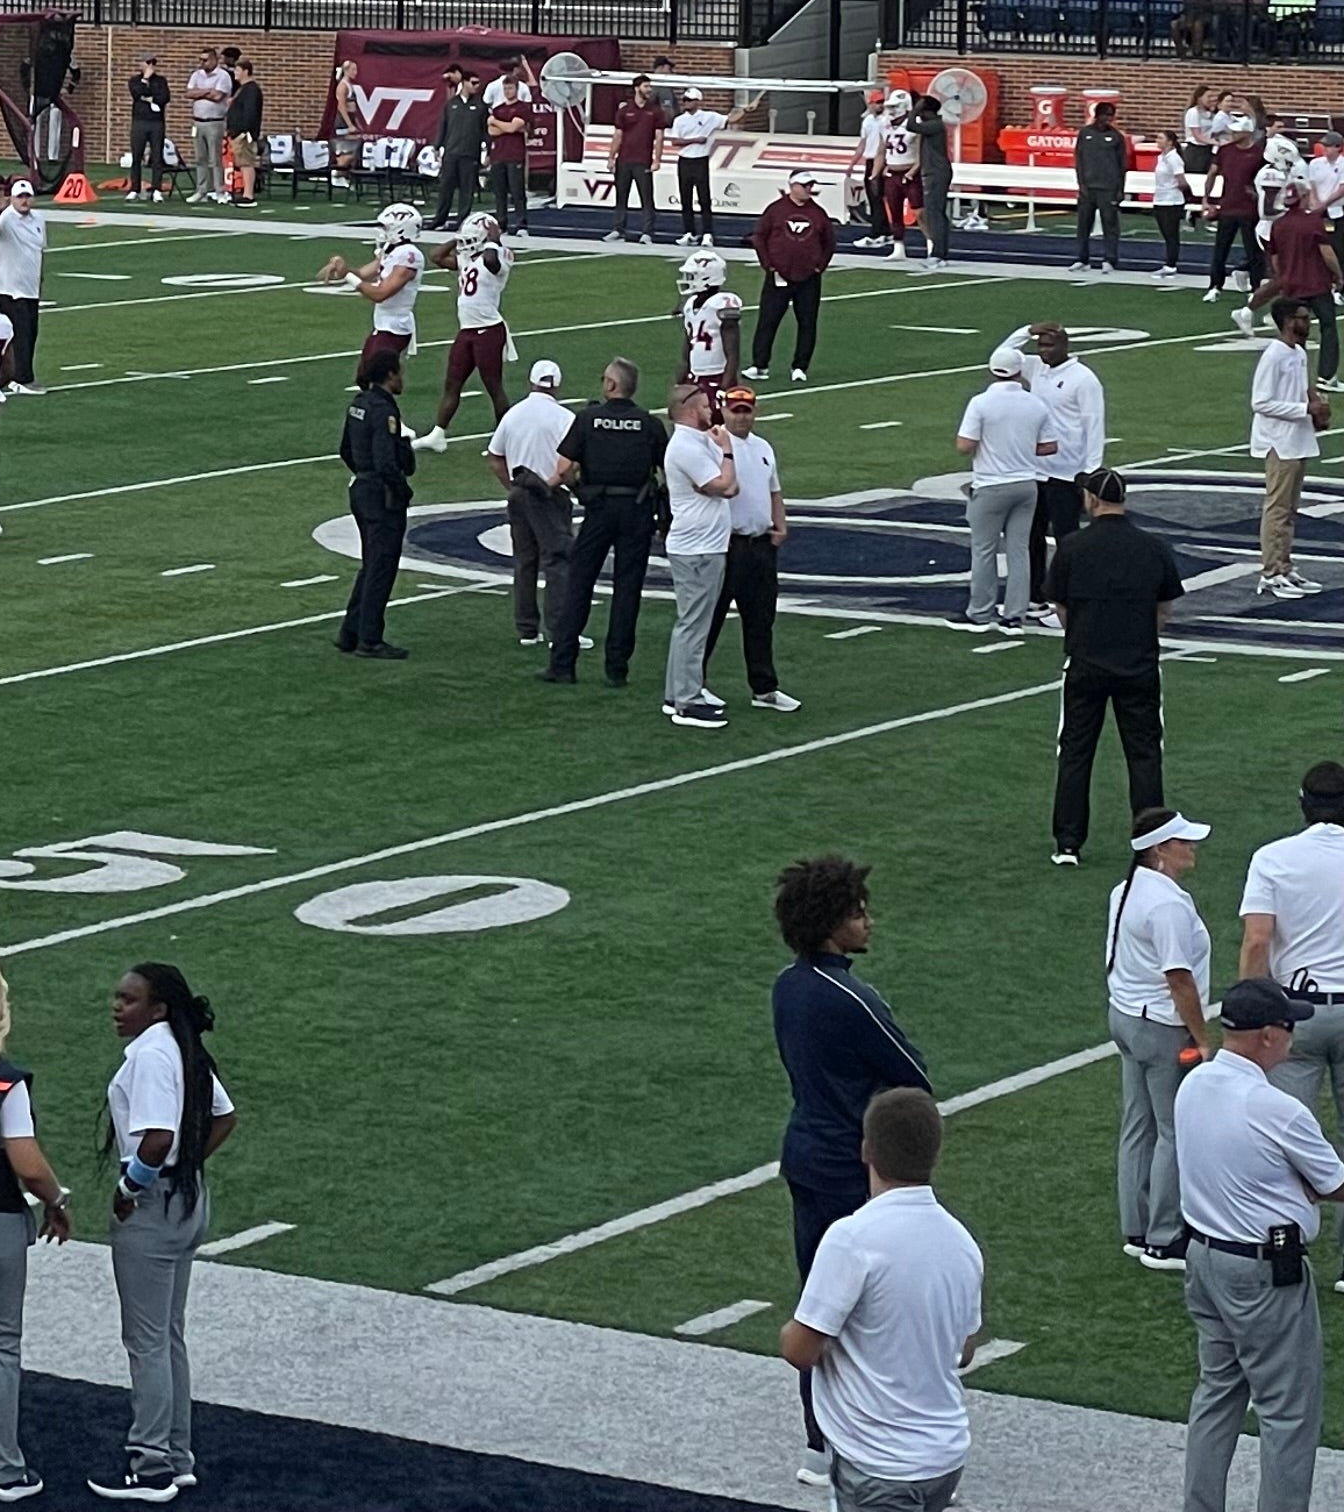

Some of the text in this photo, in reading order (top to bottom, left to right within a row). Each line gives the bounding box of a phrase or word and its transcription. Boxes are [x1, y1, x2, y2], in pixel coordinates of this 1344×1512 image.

[353, 84, 433, 130] VT
[1038, 100, 1052, 114] G
[63, 177, 83, 199] 20
[593, 417, 642, 431] POLICE
